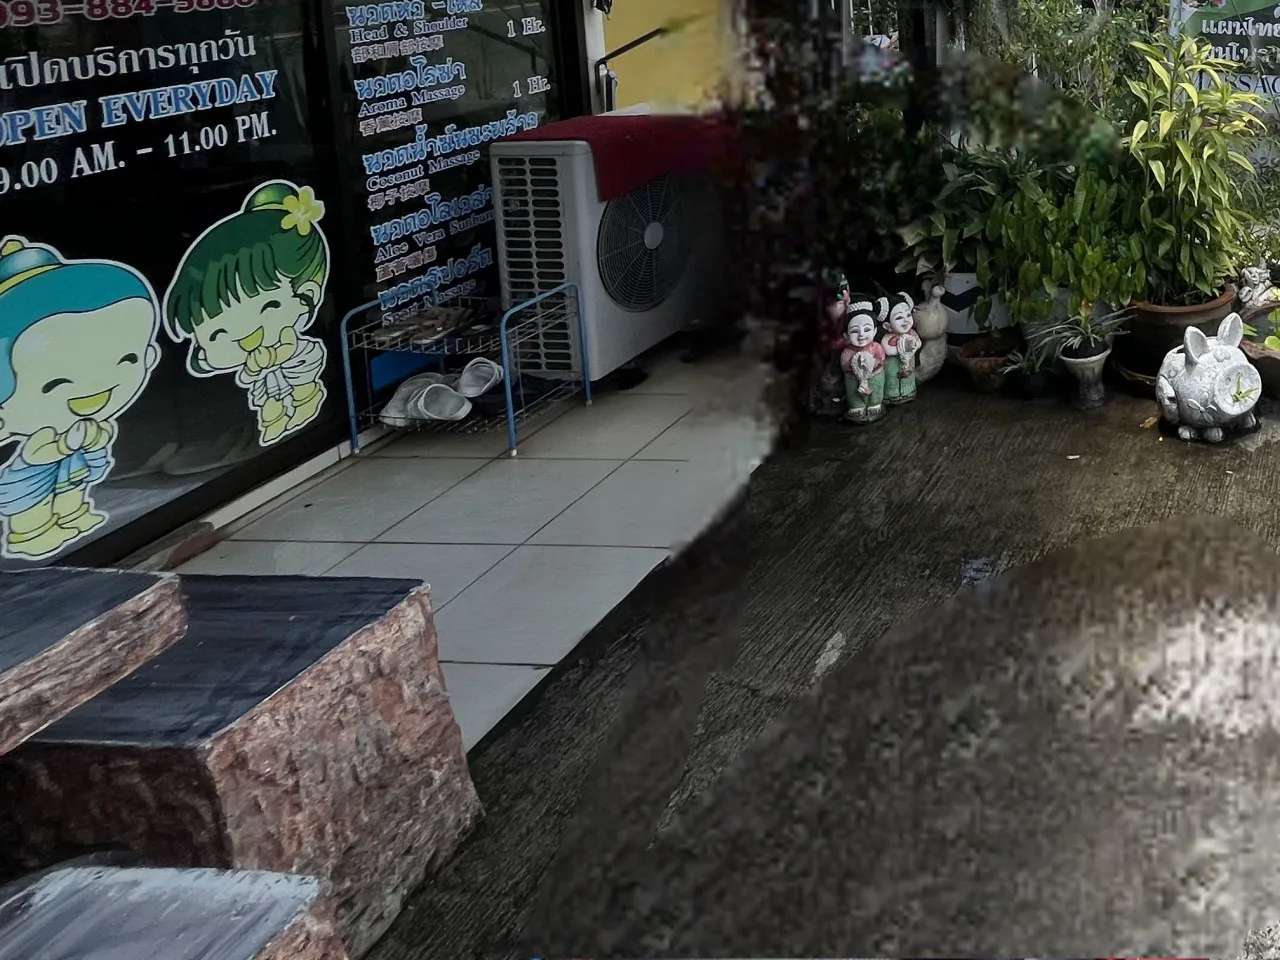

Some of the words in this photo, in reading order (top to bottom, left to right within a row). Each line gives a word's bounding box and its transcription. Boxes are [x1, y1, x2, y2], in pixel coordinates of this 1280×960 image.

[349, 28, 388, 44] Head
[394, 24, 409, 37] &
[413, 16, 468, 35] Shoulder
[507, 21, 515, 37] 1
[521, 17, 546, 35] Hr.
[0, 29, 256, 89] เปิดบริการทุกวัน
[354, 54, 466, 100] นวดอโรม่า
[358, 96, 407, 117] Aroma
[411, 84, 465, 106] Massage
[513, 81, 521, 98] 1
[527, 75, 551, 94] Hr.
[0, 100, 87, 147] PEN
[98, 70, 278, 128] EVERYDAY
[70, 141, 125, 178] AM.
[164, 124, 228, 158] 11.00
[235, 111, 277, 143] PM.
[362, 109, 539, 175] นวดน้ำมันมะพร้าว
[366, 164, 424, 191] Coconut
[428, 150, 480, 174] Massage
[374, 242, 409, 263] Aloe
[412, 228, 446, 247] Vera
